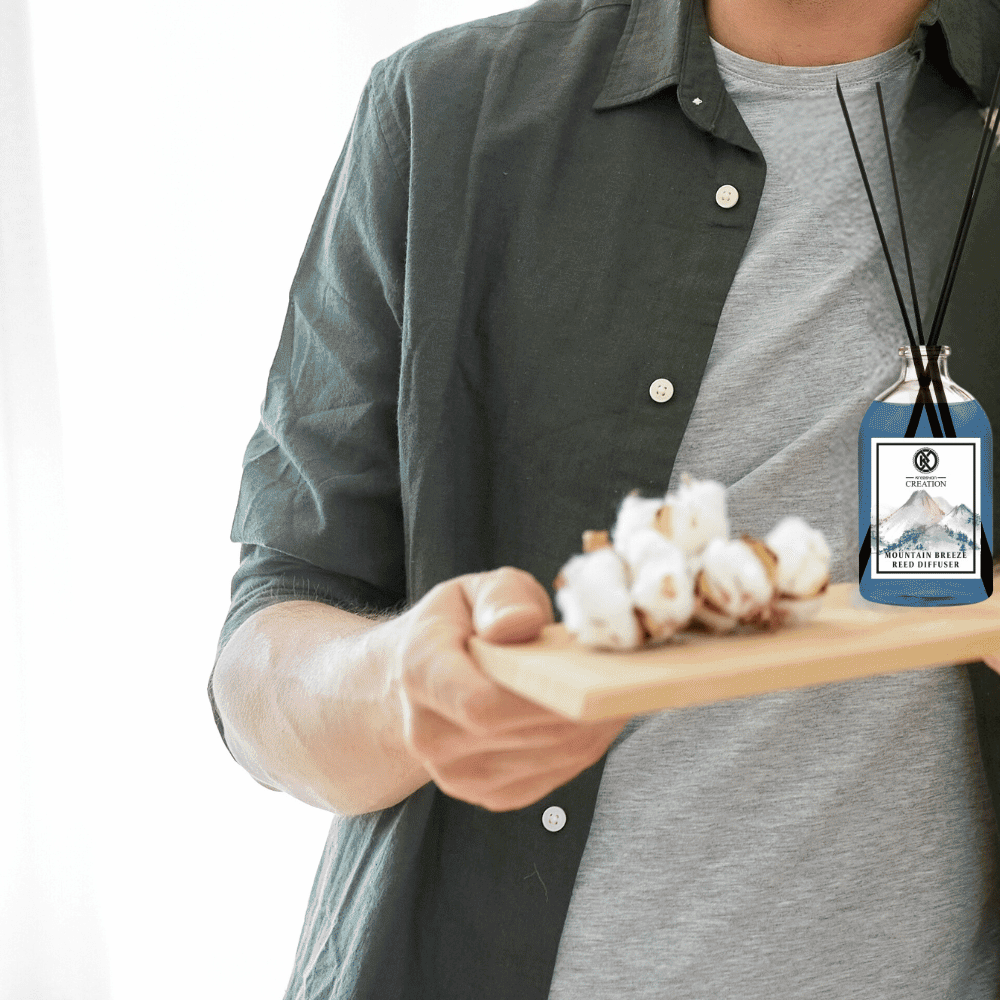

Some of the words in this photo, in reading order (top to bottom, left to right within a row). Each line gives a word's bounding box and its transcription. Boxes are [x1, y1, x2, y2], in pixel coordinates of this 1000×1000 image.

[905, 480, 947, 488] CREATION
[884, 551, 932, 559] MOUNTAIN
[934, 551, 967, 559] BREEZE
